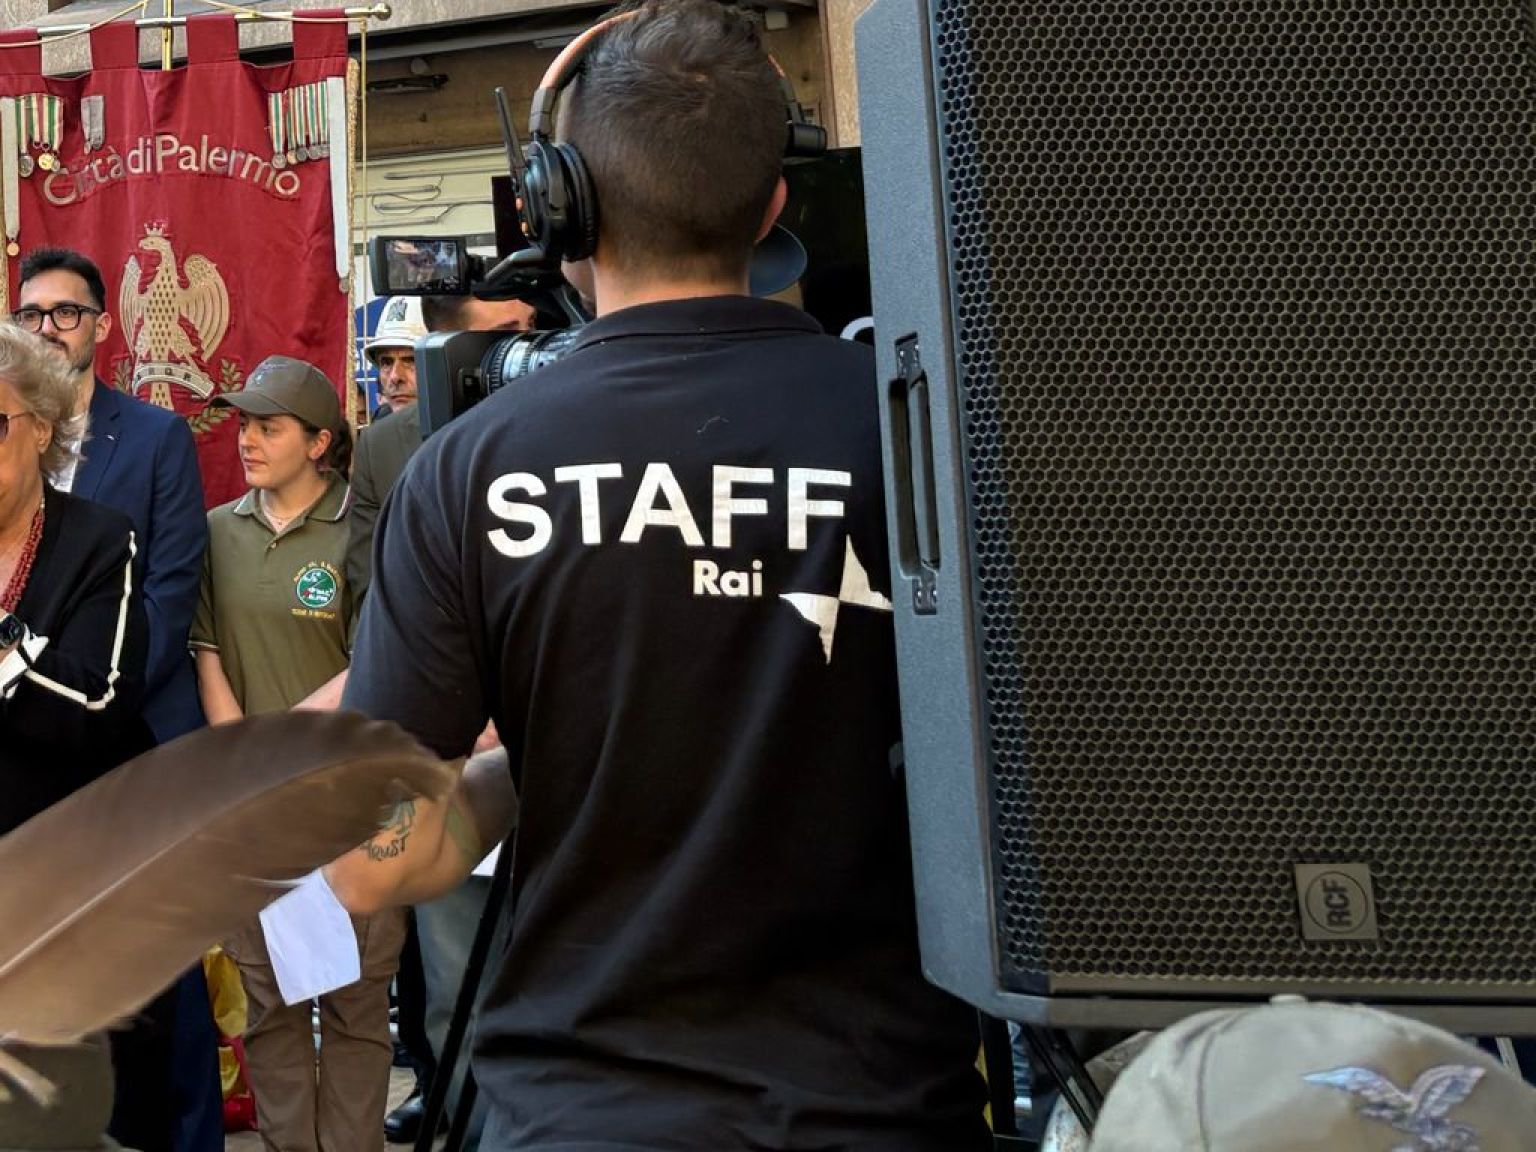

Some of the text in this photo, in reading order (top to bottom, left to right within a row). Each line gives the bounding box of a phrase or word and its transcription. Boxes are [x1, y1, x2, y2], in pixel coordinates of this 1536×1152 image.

[485, 462, 853, 559] STAFF
[692, 559, 763, 597] Rai
[1322, 878, 1353, 927] RCF
